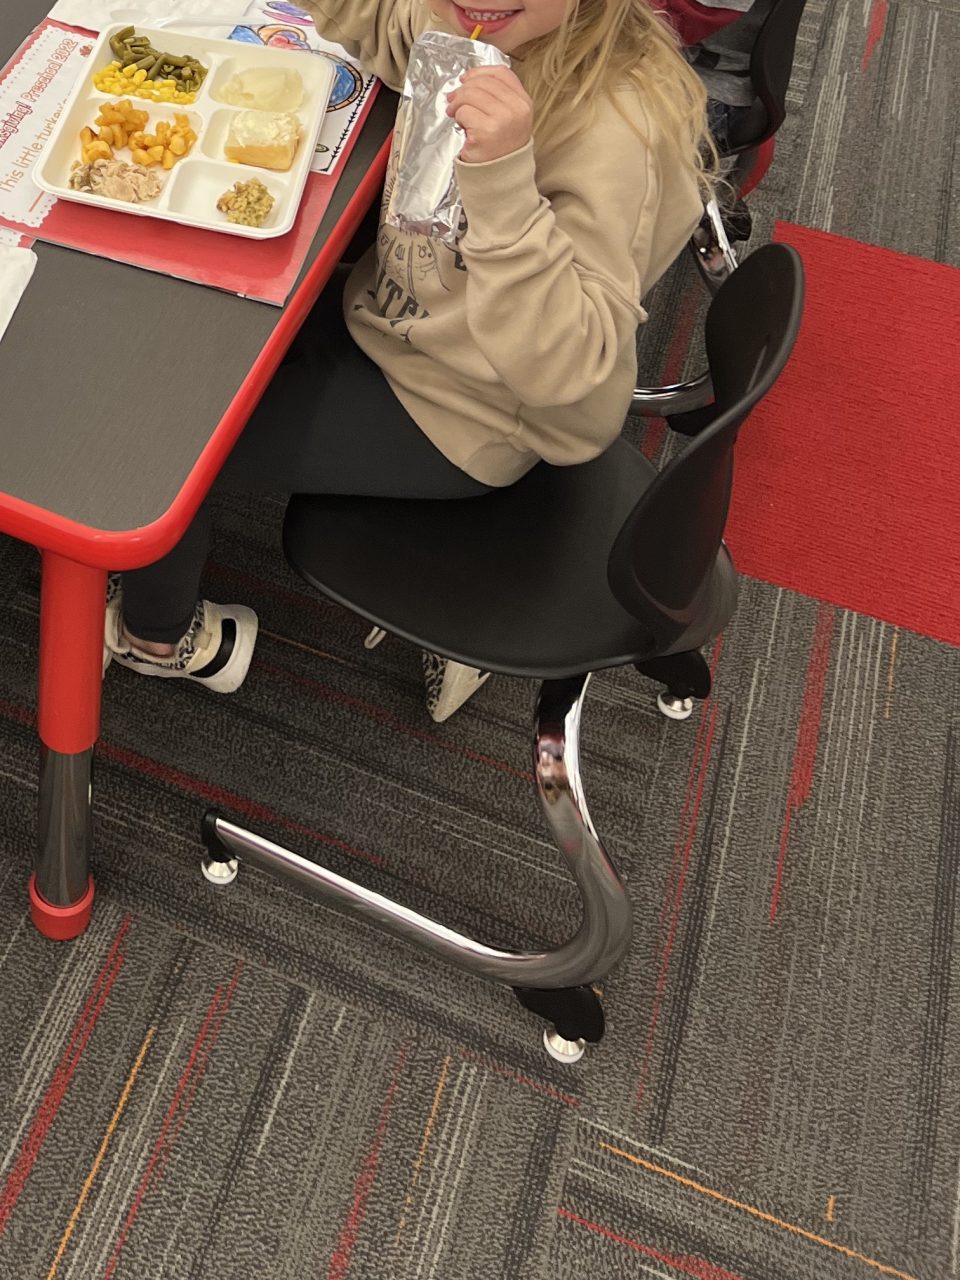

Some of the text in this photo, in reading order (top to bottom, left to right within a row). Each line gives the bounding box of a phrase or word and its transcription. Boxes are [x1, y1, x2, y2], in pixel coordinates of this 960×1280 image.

[21, 59, 61, 102] Preschool
[52, 38, 79, 67] 2022
[11, 140, 43, 171] little
